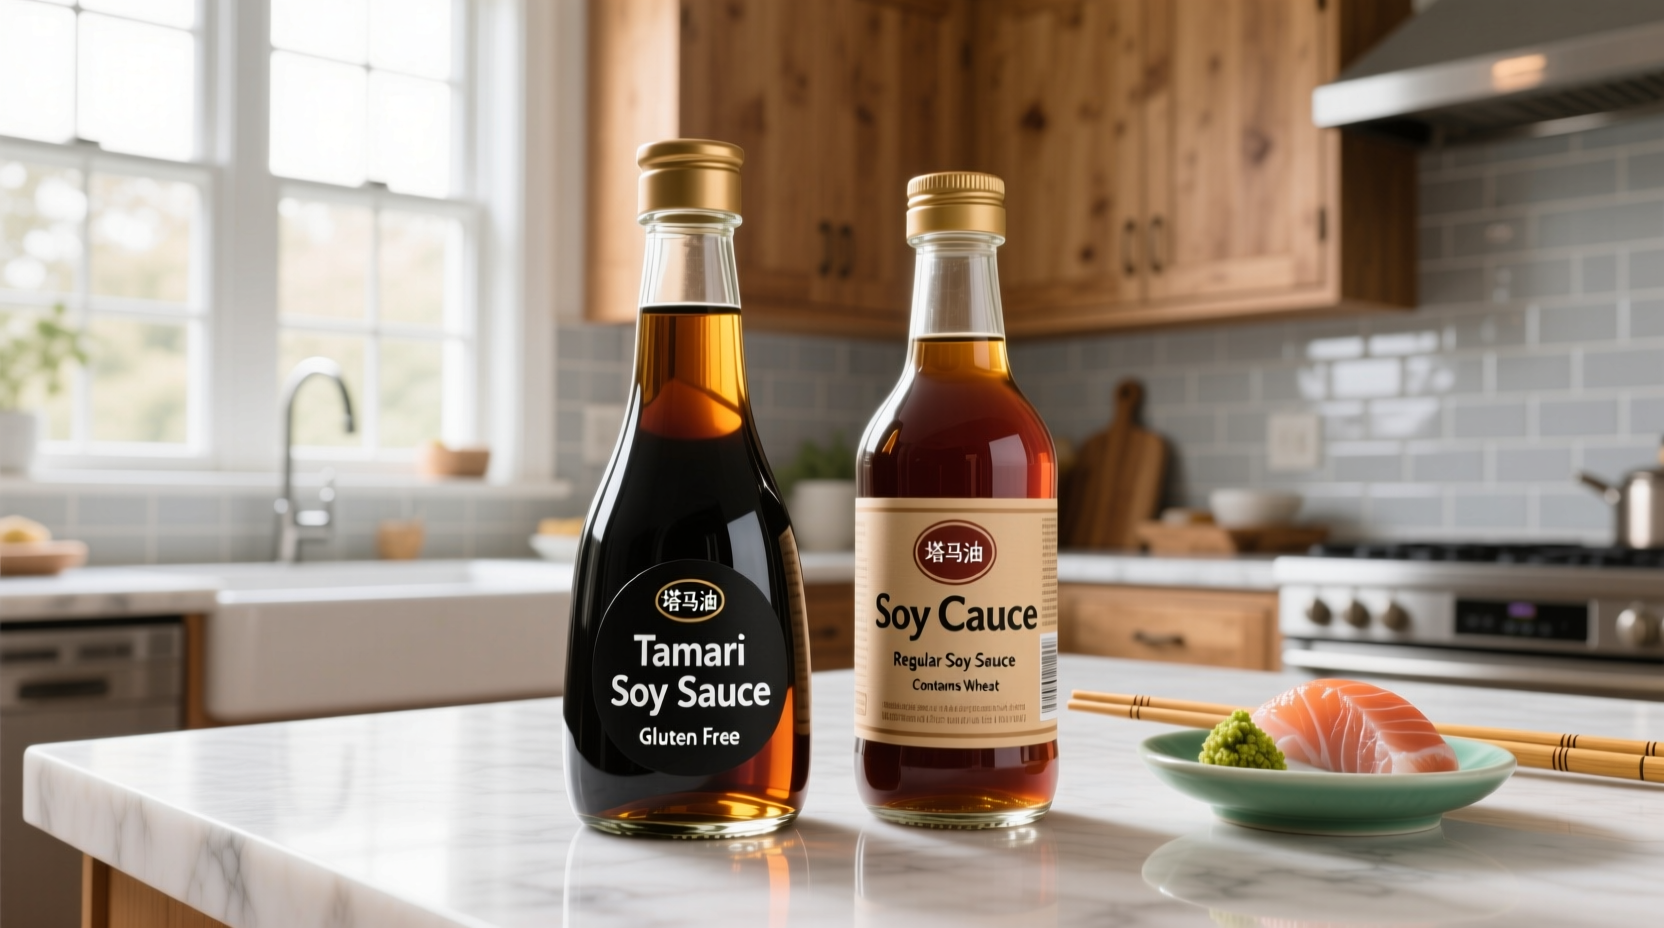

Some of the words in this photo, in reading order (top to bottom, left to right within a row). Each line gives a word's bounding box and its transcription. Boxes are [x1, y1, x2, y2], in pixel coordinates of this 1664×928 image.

[924, 540, 983, 564] 塔马油
[875, 592, 931, 641] Soy
[938, 594, 1038, 632] Cauce
[633, 633, 745, 667] Tamari
[893, 651, 942, 671] Regular
[945, 652, 971, 671] Soy
[974, 652, 1016, 668] Sauce
[611, 674, 668, 716] Soy
[677, 675, 771, 708] Sauce
[963, 678, 1000, 692] Wheat
[639, 727, 697, 746] Gluten
[703, 727, 740, 746] Free
